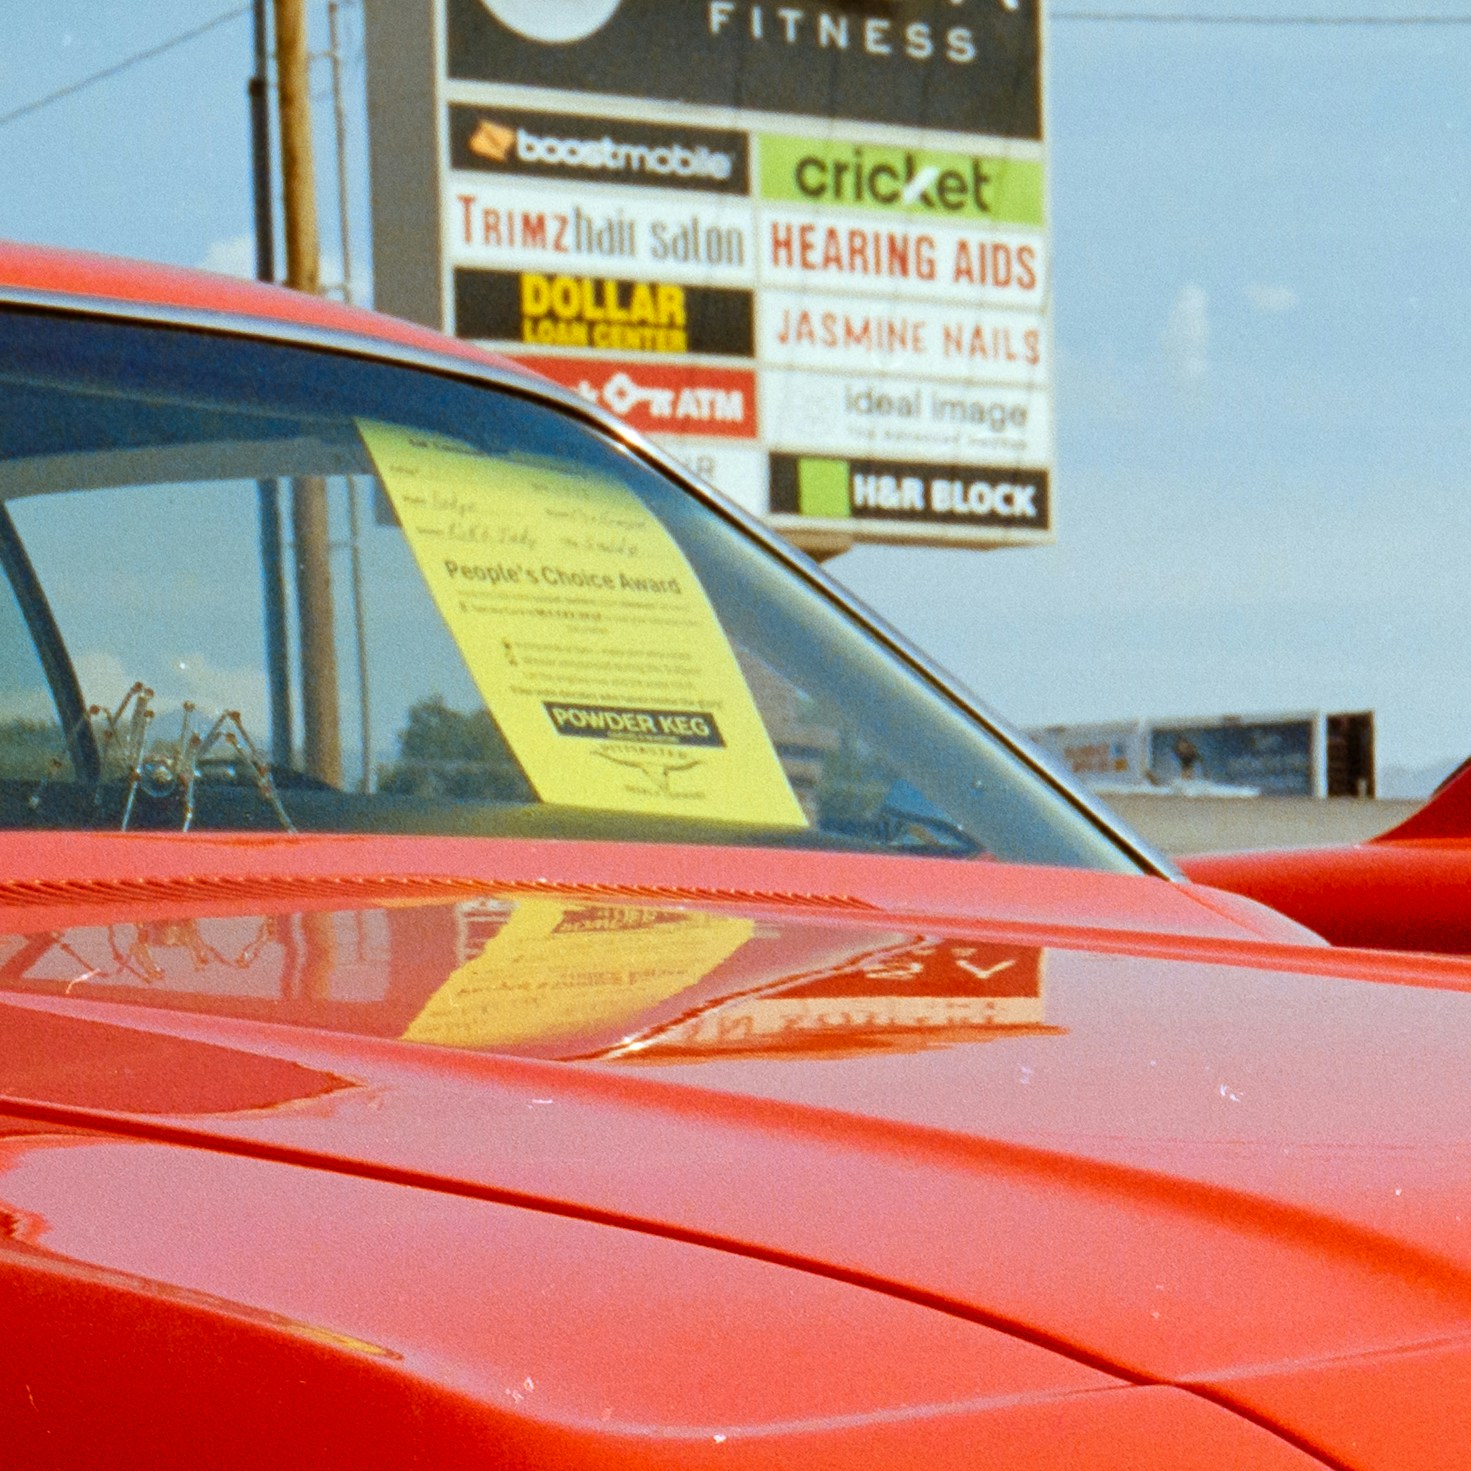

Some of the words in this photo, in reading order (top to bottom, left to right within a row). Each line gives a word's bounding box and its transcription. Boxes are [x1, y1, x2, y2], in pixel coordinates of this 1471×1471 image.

[707, 2, 977, 63] FITNESS
[794, 149, 992, 213] cricket
[650, 214, 745, 267] salon
[771, 221, 937, 282] HEARING
[953, 238, 1037, 291] AIDS
[521, 271, 686, 328] DOLLAR
[777, 309, 928, 354] JASMINE
[942, 321, 1041, 367] NAILS
[675, 387, 743, 421] ATM
[845, 383, 922, 418] ideal
[930, 390, 1028, 433] image
[852, 474, 925, 511] H&R
[930, 479, 1037, 518] BLOCK
[445, 559, 540, 586] People's
[541, 565, 616, 591] Choice
[618, 571, 682, 596] Award
[552, 707, 658, 735] POWDER
[658, 715, 710, 737] KEG
